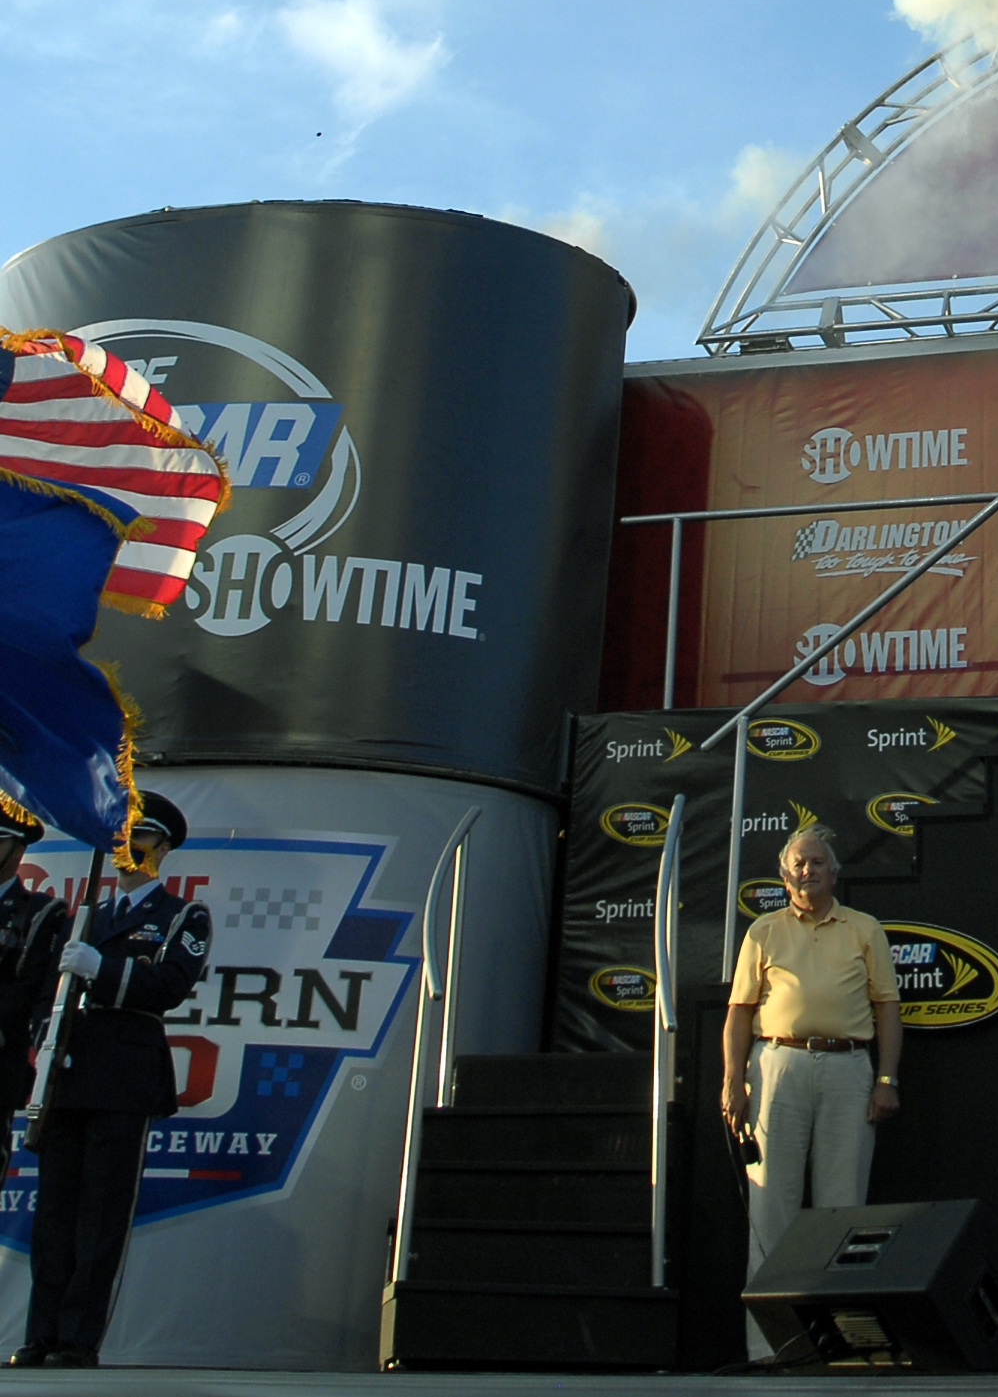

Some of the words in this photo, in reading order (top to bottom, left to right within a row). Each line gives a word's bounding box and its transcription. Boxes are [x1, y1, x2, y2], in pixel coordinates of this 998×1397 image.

[801, 427, 968, 484] SHOWTIME
[185, 534, 483, 640] SHOWTIME
[794, 623, 968, 686] SHOWTIME
[606, 739, 663, 763] Sprint
[765, 736, 793, 748] Sprint
[867, 728, 926, 751] Sprint
[627, 820, 655, 833] Sprint
[741, 812, 789, 837] print
[595, 899, 654, 923] Sprint
[759, 897, 787, 909] Sprint
[890, 943, 933, 965] SCAR
[616, 985, 644, 997] Sprint
[899, 1005, 922, 1017] UP
[924, 1002, 988, 1015] SERIES
[146, 1130, 278, 1155] CEWAY
